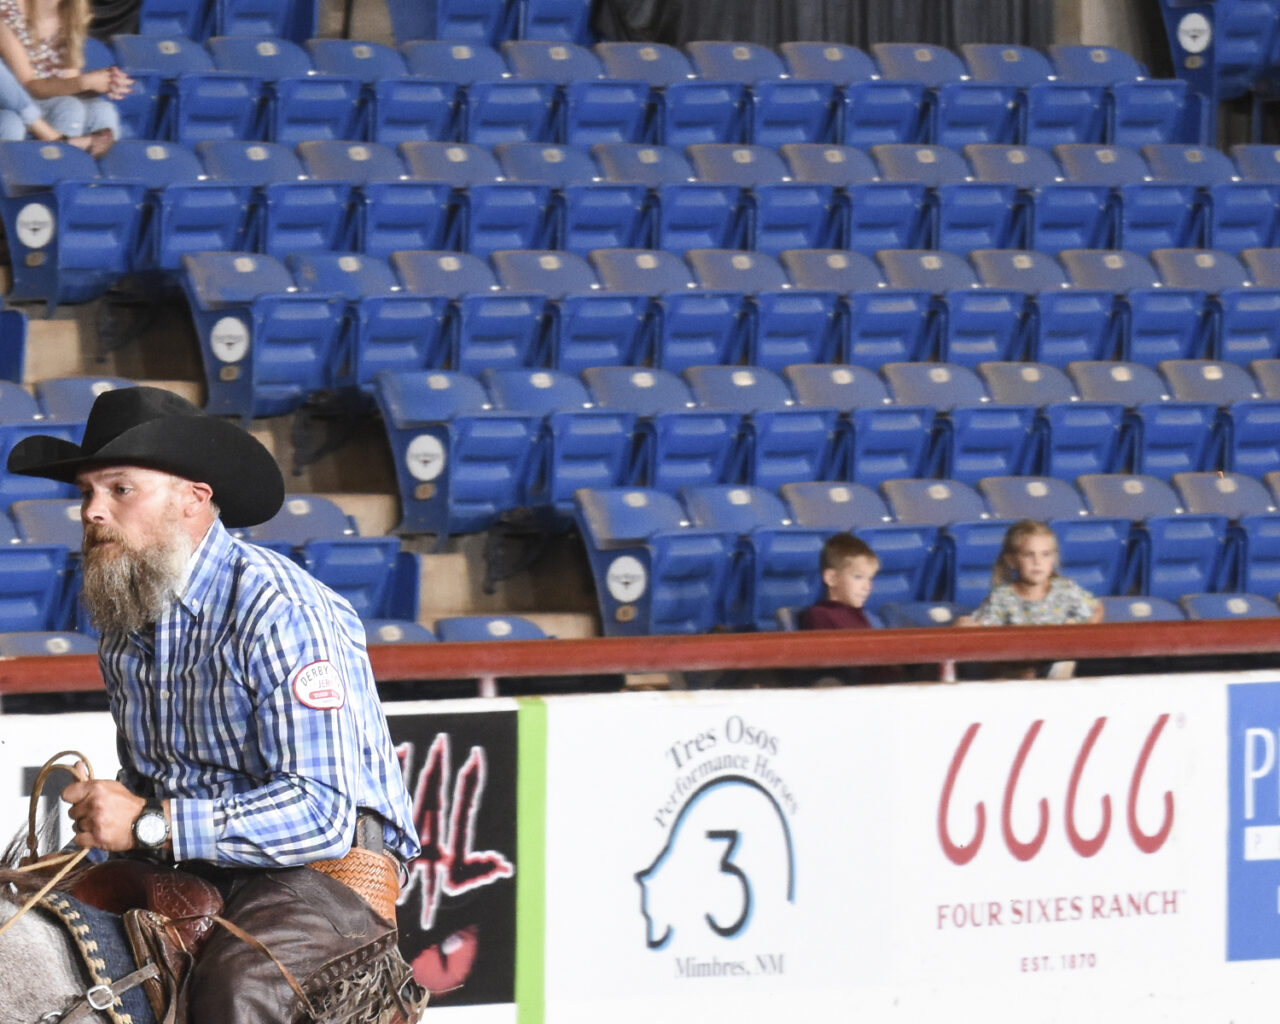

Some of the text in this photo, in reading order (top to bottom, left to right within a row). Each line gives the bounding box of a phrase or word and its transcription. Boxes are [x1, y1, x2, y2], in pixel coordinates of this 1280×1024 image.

[300, 664, 330, 688] DERBY
[666, 714, 780, 771] Tres Osos
[653, 753, 800, 829] Performance Horses
[937, 712, 1176, 867] 6666
[704, 829, 755, 940] 3
[936, 889, 1180, 931] FOUR SIXES RANCH
[674, 953, 787, 980] Mimbres, NM
[1020, 952, 1098, 973] EST. 1870
